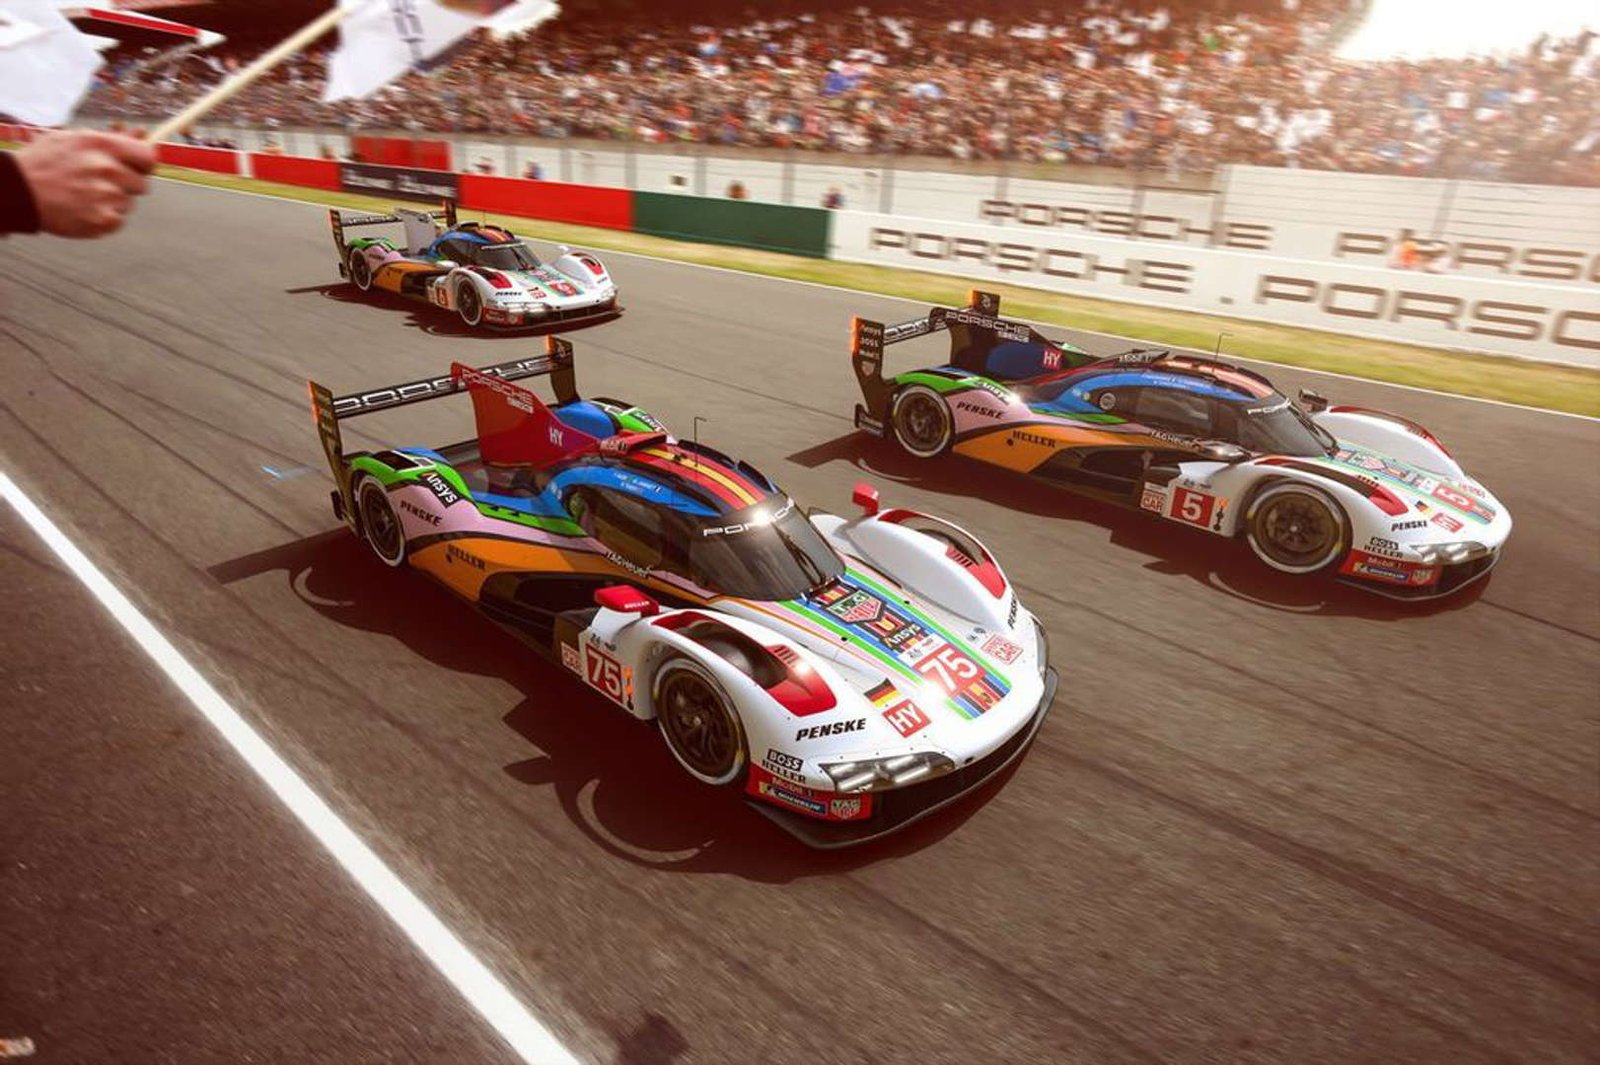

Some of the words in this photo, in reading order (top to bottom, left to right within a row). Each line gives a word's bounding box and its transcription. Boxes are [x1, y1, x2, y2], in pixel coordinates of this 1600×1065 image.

[980, 199, 1273, 251] PORSCHE
[872, 226, 1194, 294] PORSCHE
[1254, 274, 1600, 349] PORSC
[945, 311, 1031, 338] PORSCHE
[1043, 350, 1061, 368] HY
[461, 368, 534, 407] PORSCHE
[956, 401, 1004, 420] PENSKE
[550, 427, 563, 447] HY
[1013, 430, 1056, 448] HELLER
[422, 472, 457, 504] Ansys
[400, 500, 443, 527] PENSKE
[1181, 491, 1204, 521] 5
[587, 647, 621, 697] 75
[918, 648, 979, 692] 75
[795, 718, 866, 741] PENSKE
[887, 701, 922, 734] HY
[762, 759, 806, 784] HELLER
[769, 751, 801, 770] BOSS
